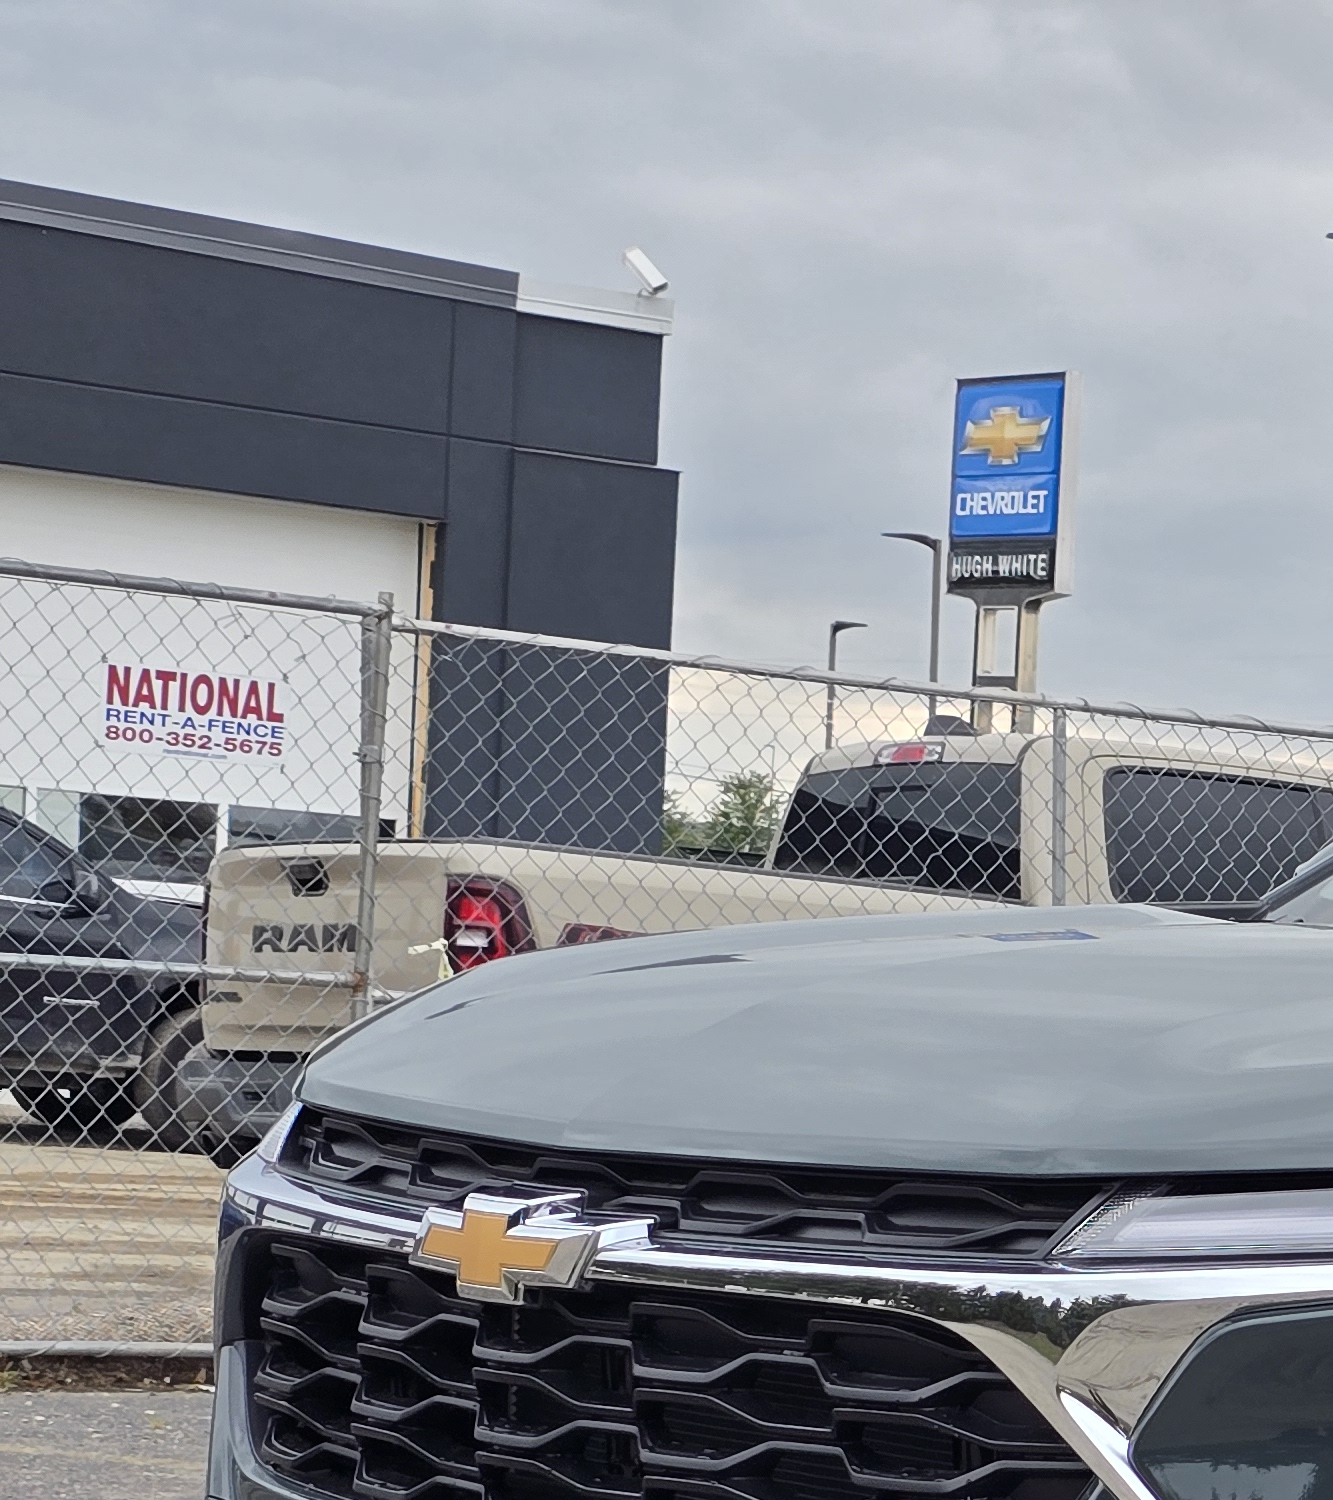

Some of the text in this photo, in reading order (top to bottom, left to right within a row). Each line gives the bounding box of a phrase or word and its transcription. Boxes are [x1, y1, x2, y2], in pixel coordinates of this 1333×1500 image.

[955, 490, 1049, 516] CHEVROLET
[106, 664, 285, 724] NATIONAL
[105, 707, 285, 740] RENT-A-FENCE
[104, 725, 283, 757] 800-352-5675
[252, 922, 358, 954] RAM
